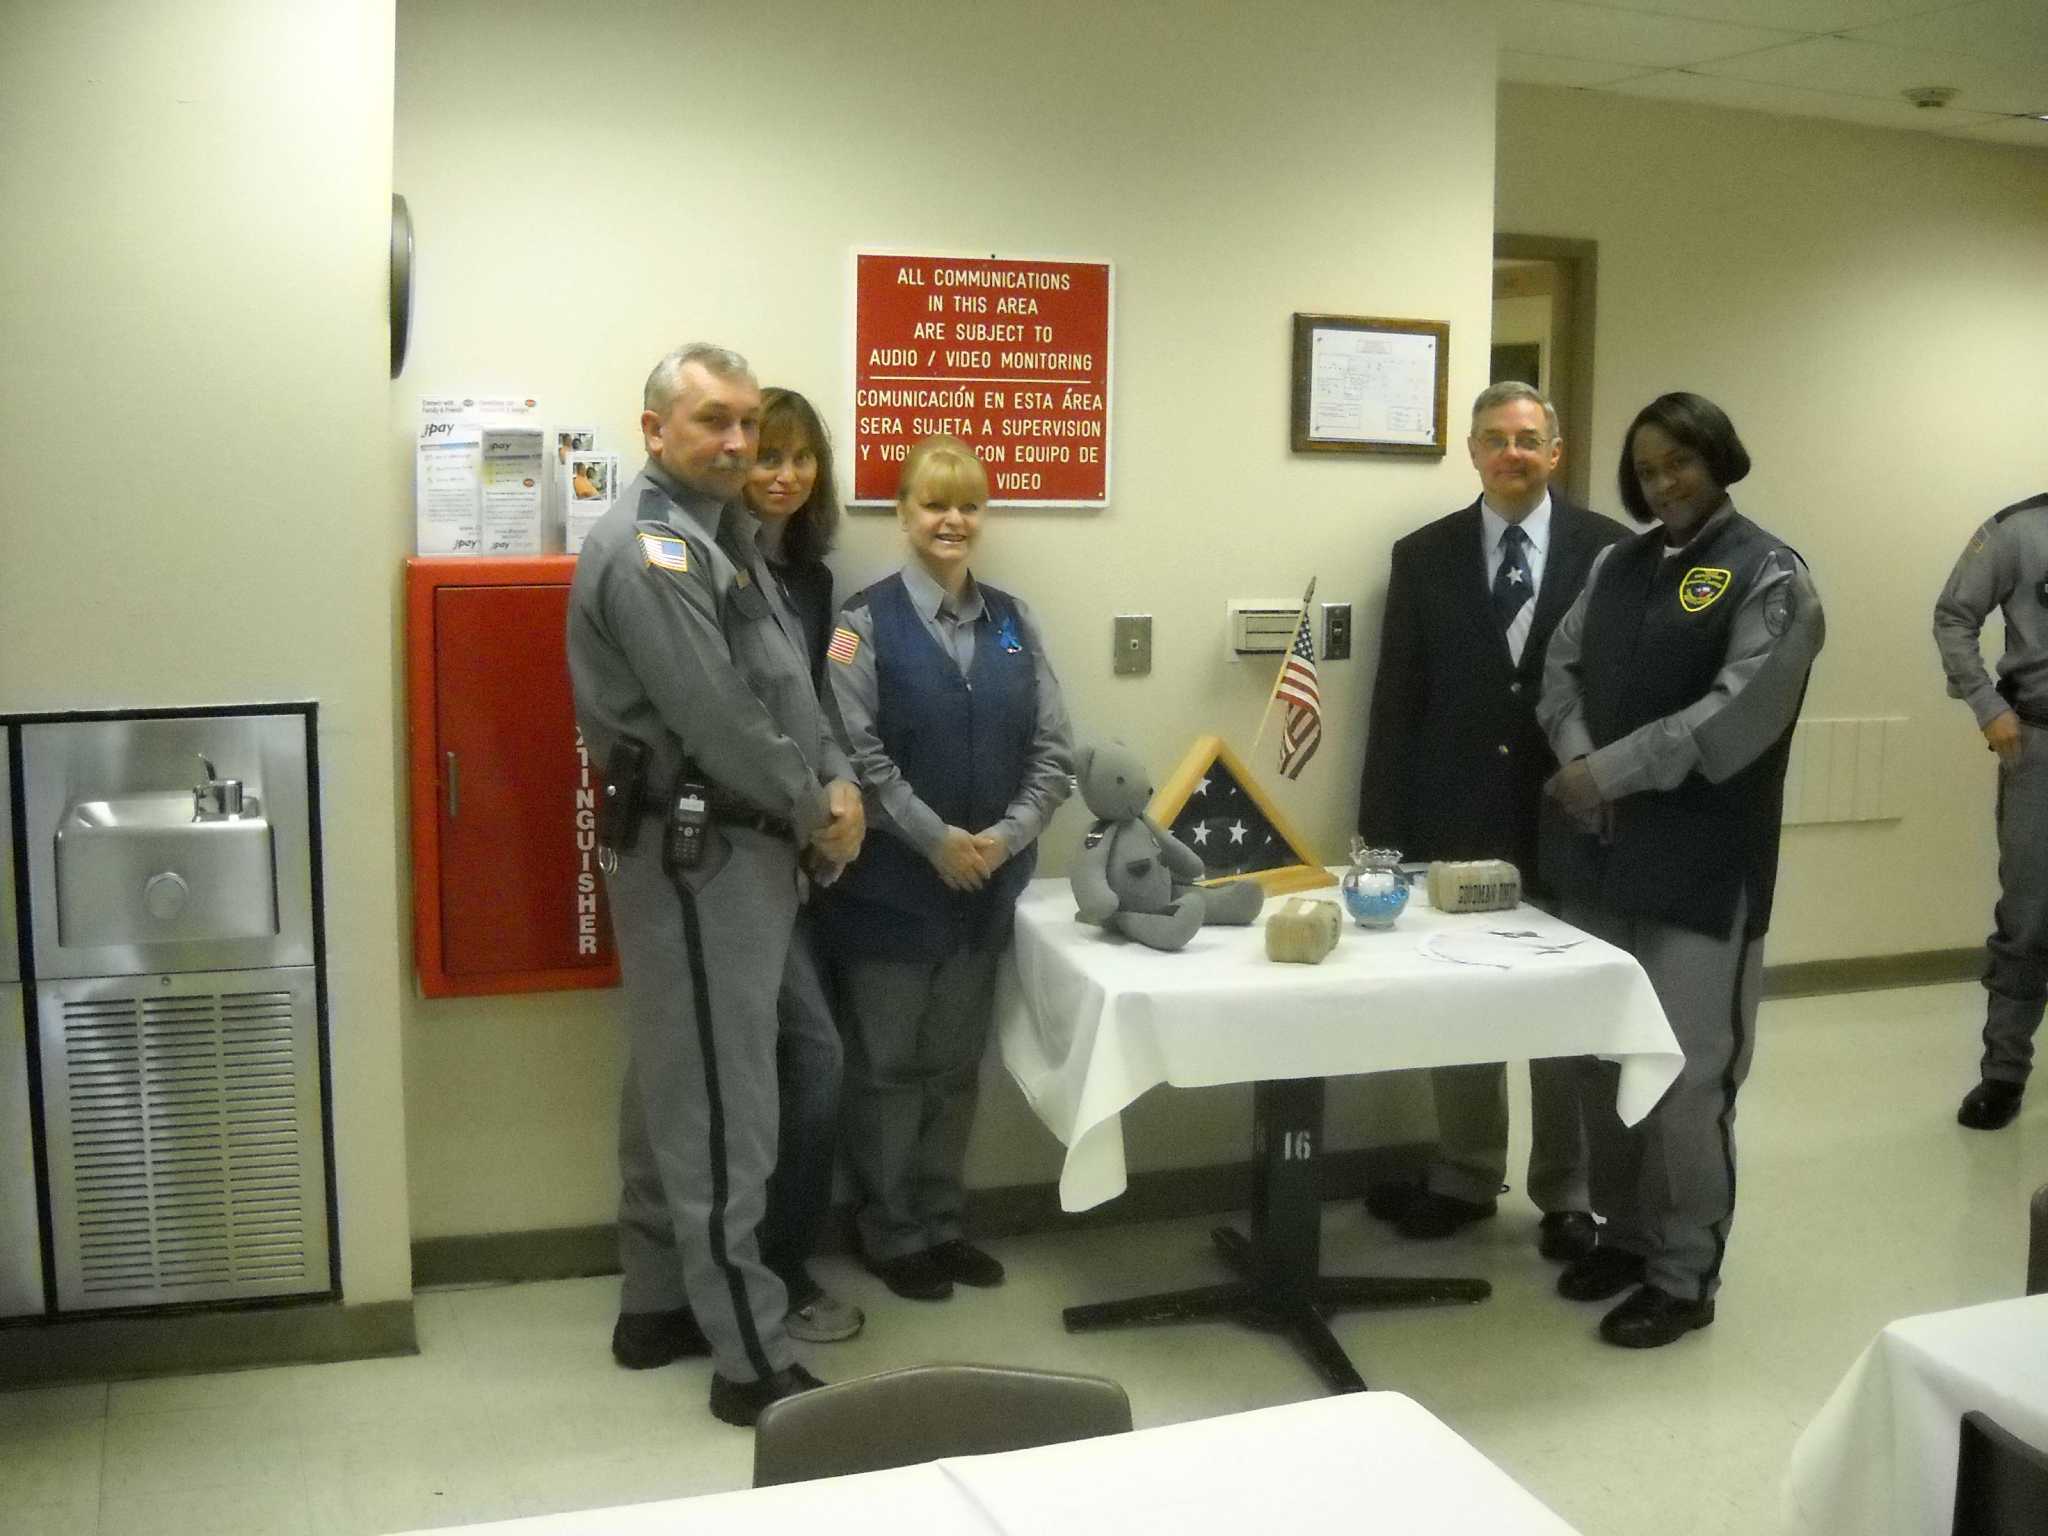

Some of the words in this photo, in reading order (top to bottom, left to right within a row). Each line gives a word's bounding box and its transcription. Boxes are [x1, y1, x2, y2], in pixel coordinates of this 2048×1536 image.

[898, 268, 925, 285] ALL
[934, 269, 1070, 290] COMMUNICATIONS
[928, 296, 943, 312] IN
[954, 297, 987, 313] THIS
[997, 298, 1038, 315] AREA
[914, 323, 945, 340] ARE
[956, 324, 1024, 341] SUBJECT
[1035, 327, 1053, 342] TO
[869, 350, 917, 366] AUDIO
[928, 351, 935, 366] /
[946, 351, 991, 368] VIDEO
[1001, 353, 1092, 370] MONITORING
[857, 386, 974, 408] COMUNICACIÓN
[985, 392, 1004, 409] EN
[1014, 393, 1053, 409] ESTA
[1062, 388, 1103, 410] ÁREA
[860, 418, 902, 434] SERA
[913, 419, 972, 435] SUJETA
[982, 419, 992, 435] A
[1002, 419, 1100, 437] SUPERVISION
[861, 445, 870, 461] Y
[975, 446, 1005, 462] CON
[1016, 446, 1069, 463] EQUIPO
[1079, 447, 1098, 463] DE
[997, 473, 1041, 490] VIDEO
[1285, 1131, 1311, 1160] 16
